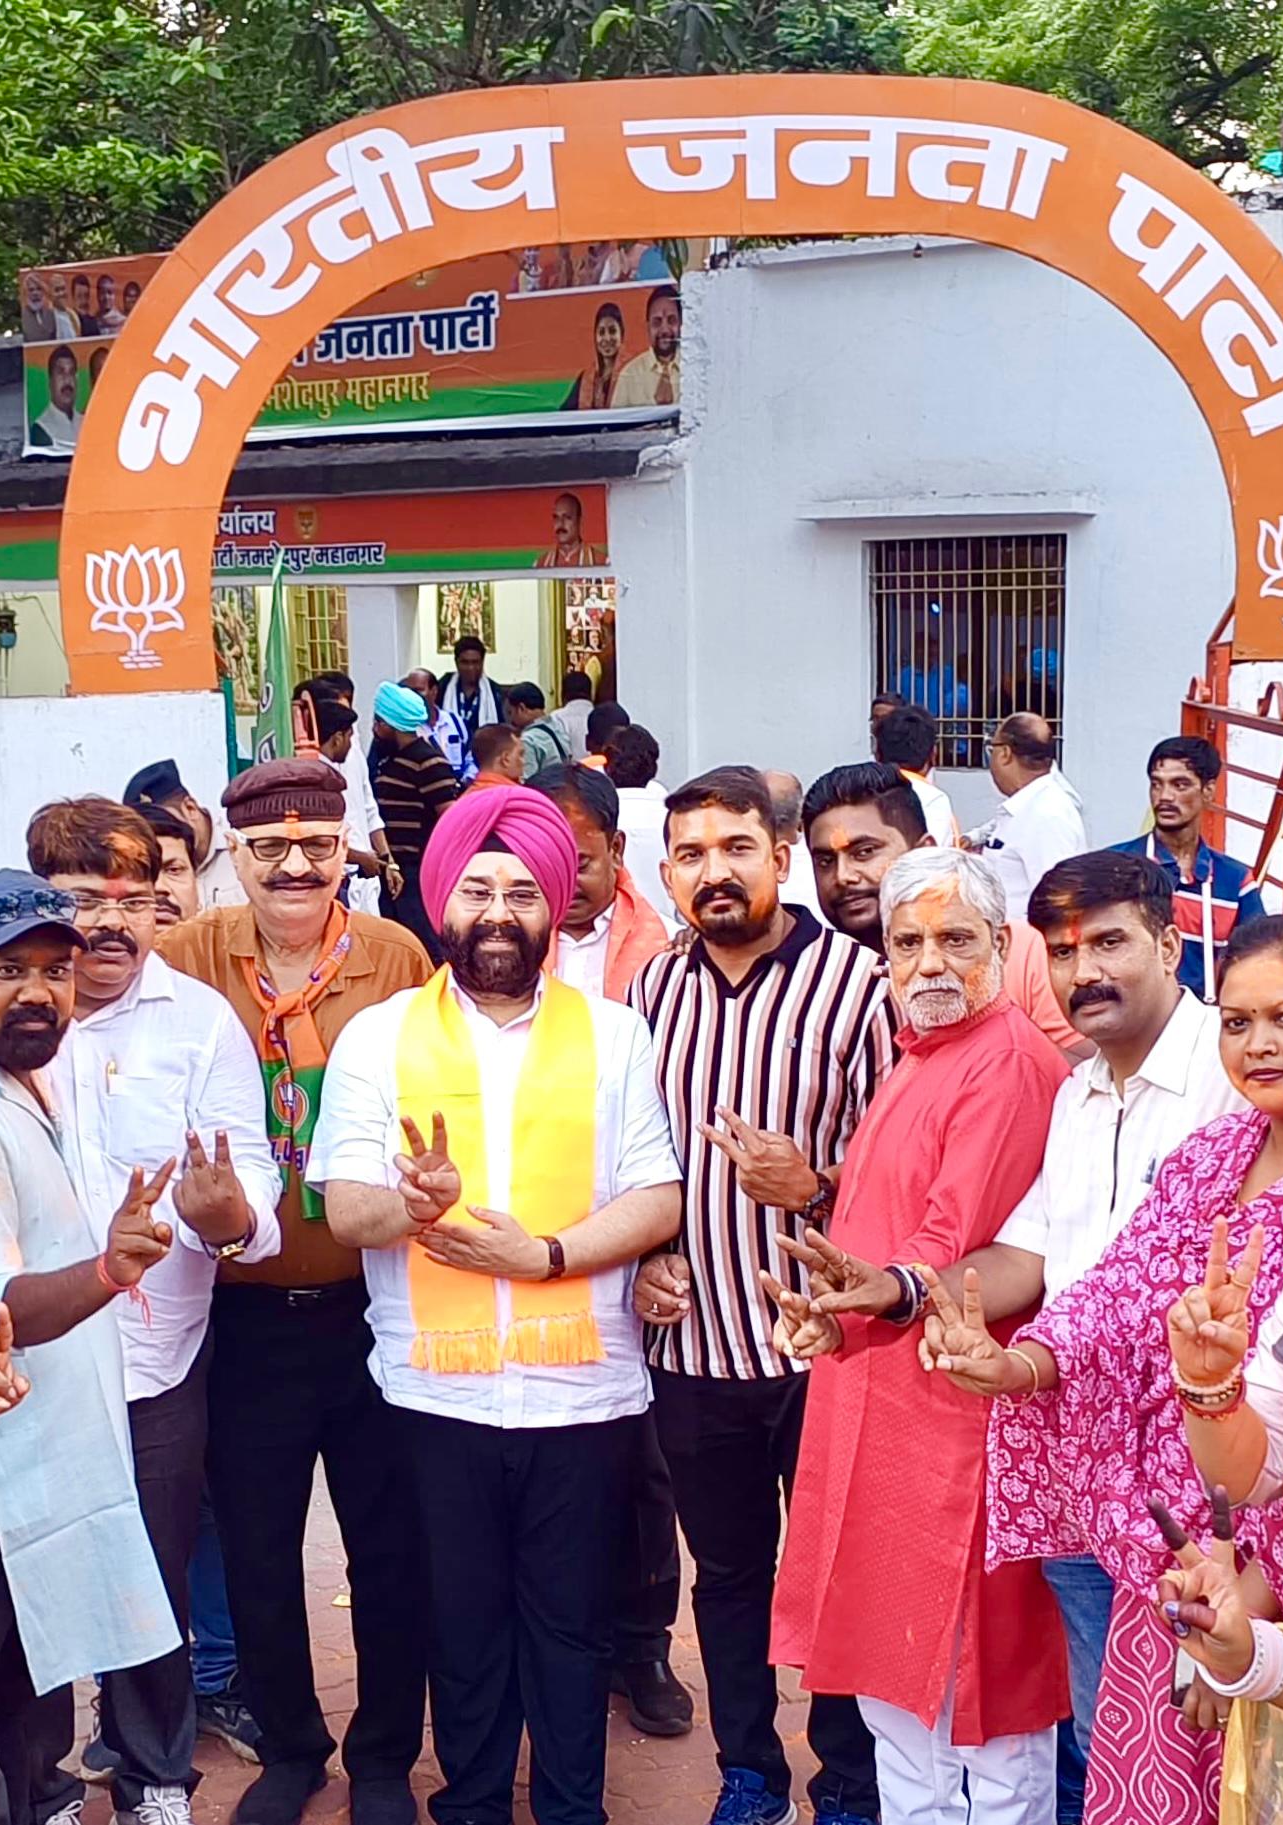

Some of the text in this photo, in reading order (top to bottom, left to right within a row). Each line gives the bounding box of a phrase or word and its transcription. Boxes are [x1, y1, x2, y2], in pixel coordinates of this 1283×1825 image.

[118, 126, 565, 472] भारतीय
[622, 114, 1069, 220] जनता
[316, 315, 415, 363] जनता
[418, 290, 499, 354] पार्टी
[261, 372, 430, 419] मशेदपुर महानगर
[216, 504, 276, 535] ार्यालय
[315, 542, 385, 567] महानगर
